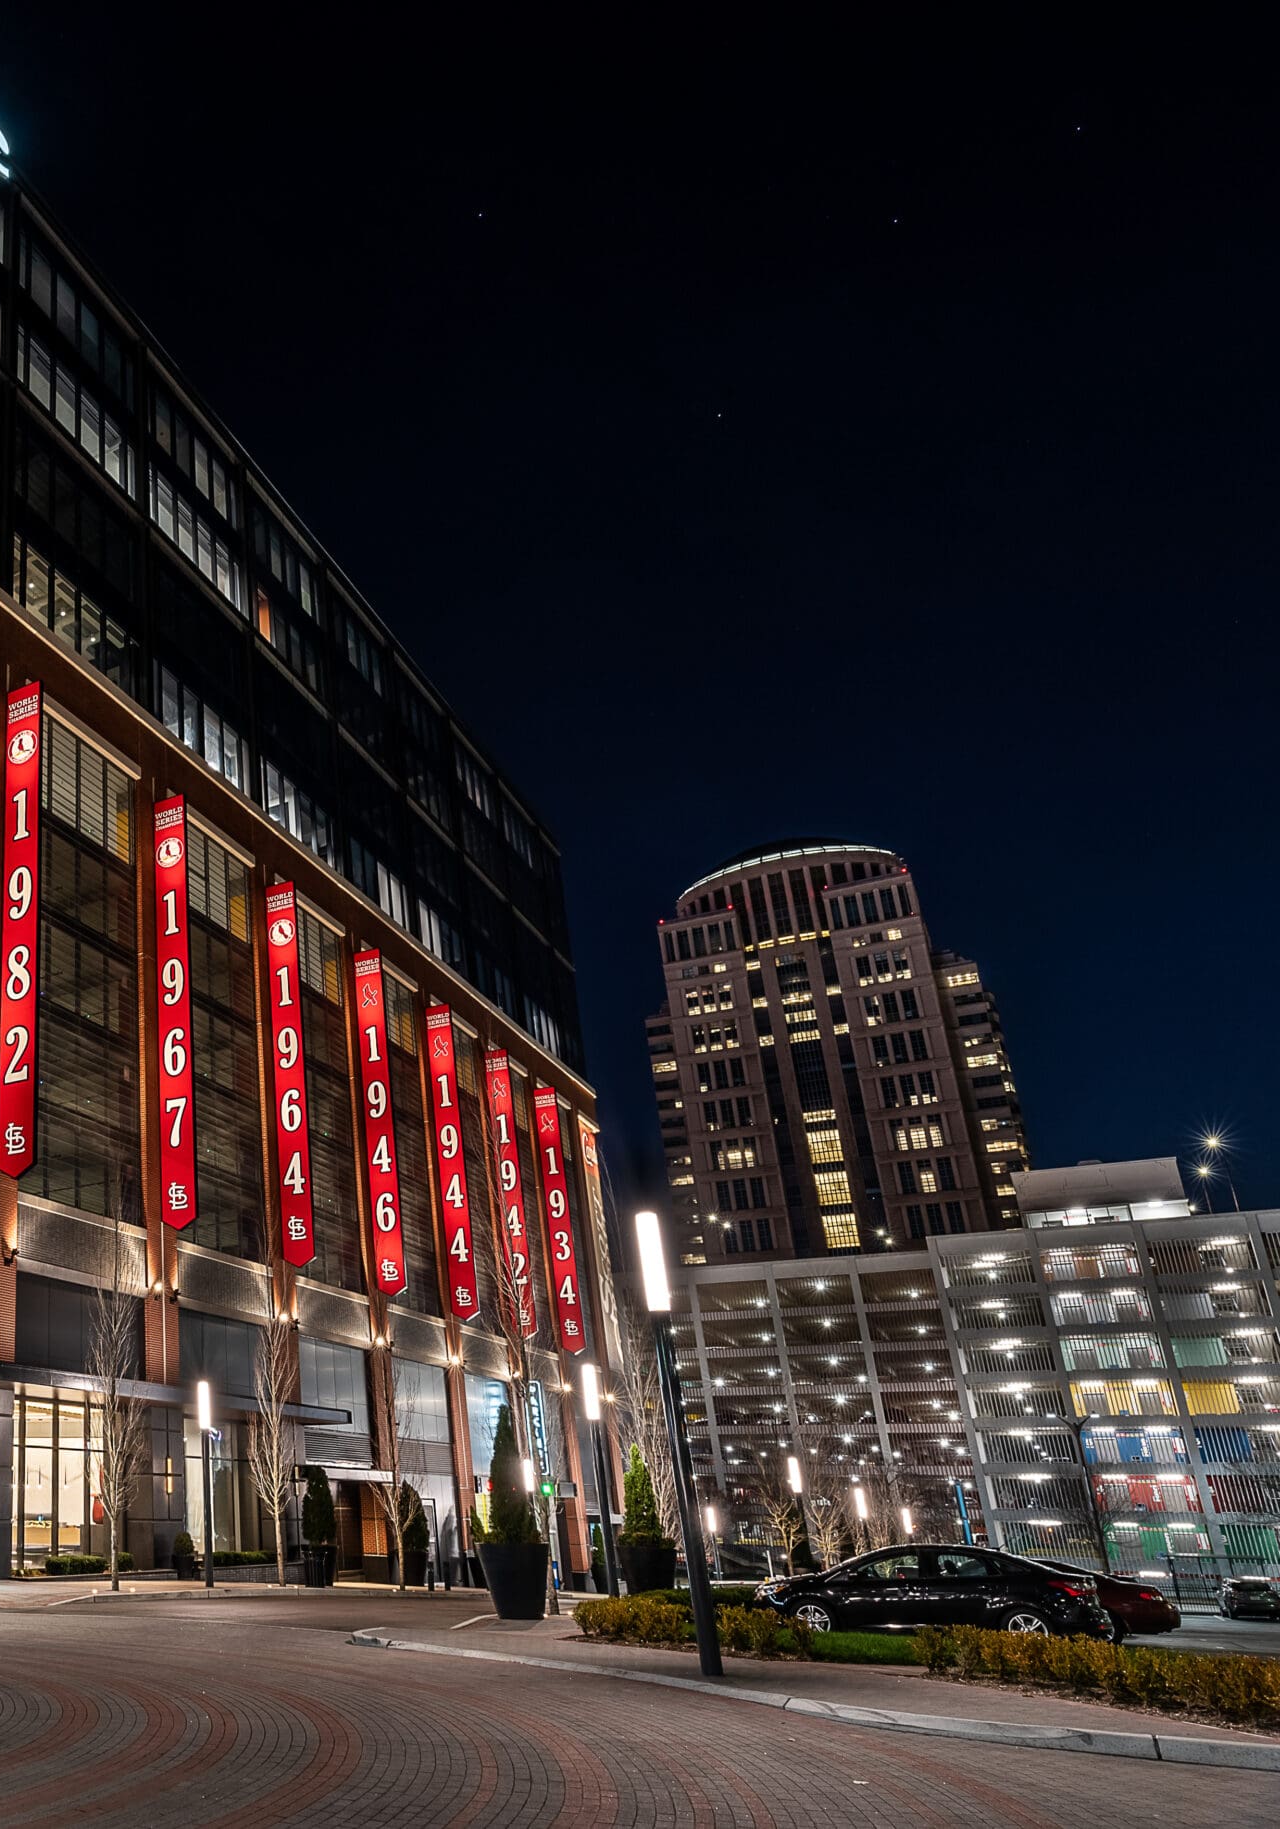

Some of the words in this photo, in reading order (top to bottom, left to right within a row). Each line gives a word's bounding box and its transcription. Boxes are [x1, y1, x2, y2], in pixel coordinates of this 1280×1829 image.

[8, 695, 38, 711] WORLD
[9, 702, 38, 719] SERIES
[155, 806, 183, 820] WORLD
[155, 813, 182, 827] SERIES
[3, 788, 33, 1085] 1982
[266, 891, 294, 903] WORLD
[267, 897, 293, 908] SERIES
[355, 957, 380, 967] WORLD
[161, 889, 187, 1149] 1967
[275, 965, 306, 1195] 1964
[365, 1025, 397, 1233] 1946
[436, 1073, 469, 1264] 1944
[496, 1112, 528, 1285] 1942
[544, 1147, 576, 1305] 1934
